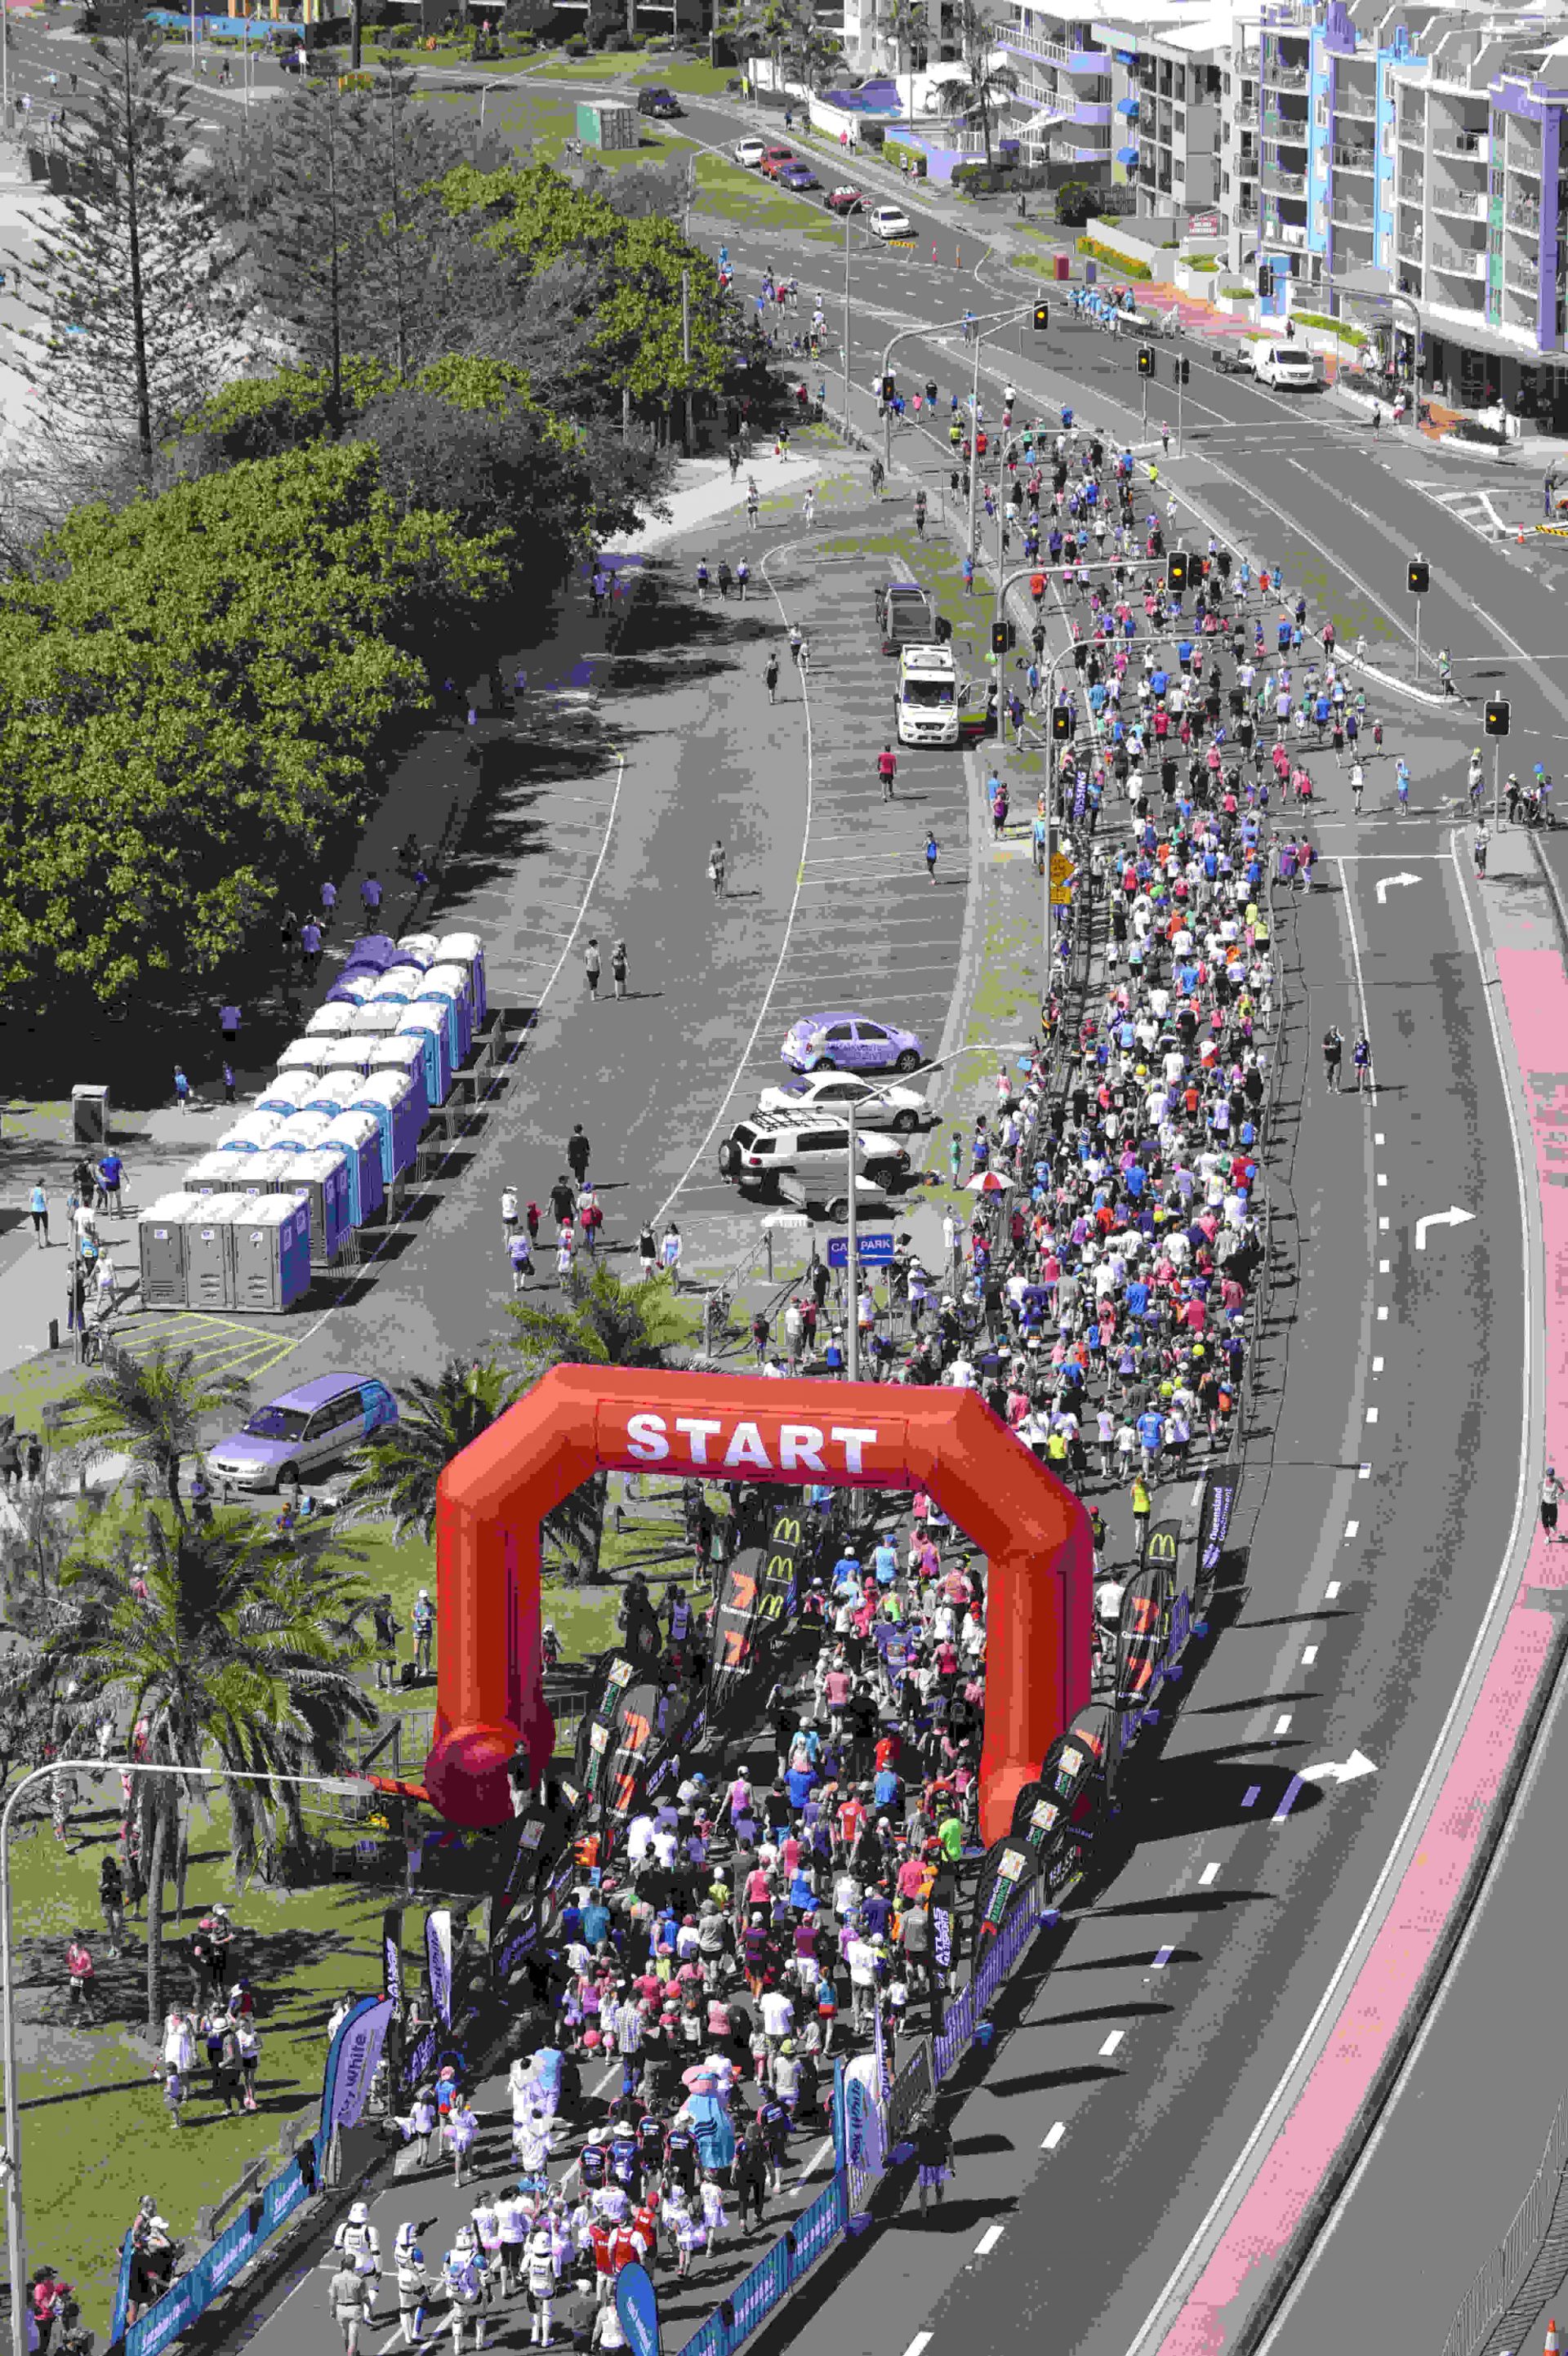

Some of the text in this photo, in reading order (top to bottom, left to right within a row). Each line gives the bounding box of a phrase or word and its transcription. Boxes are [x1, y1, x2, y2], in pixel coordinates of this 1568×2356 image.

[861, 1239, 890, 1250] PARK
[627, 1414, 877, 1473] START
[1209, 1487, 1223, 1541] Queensland
[345, 2033, 367, 2087] White
